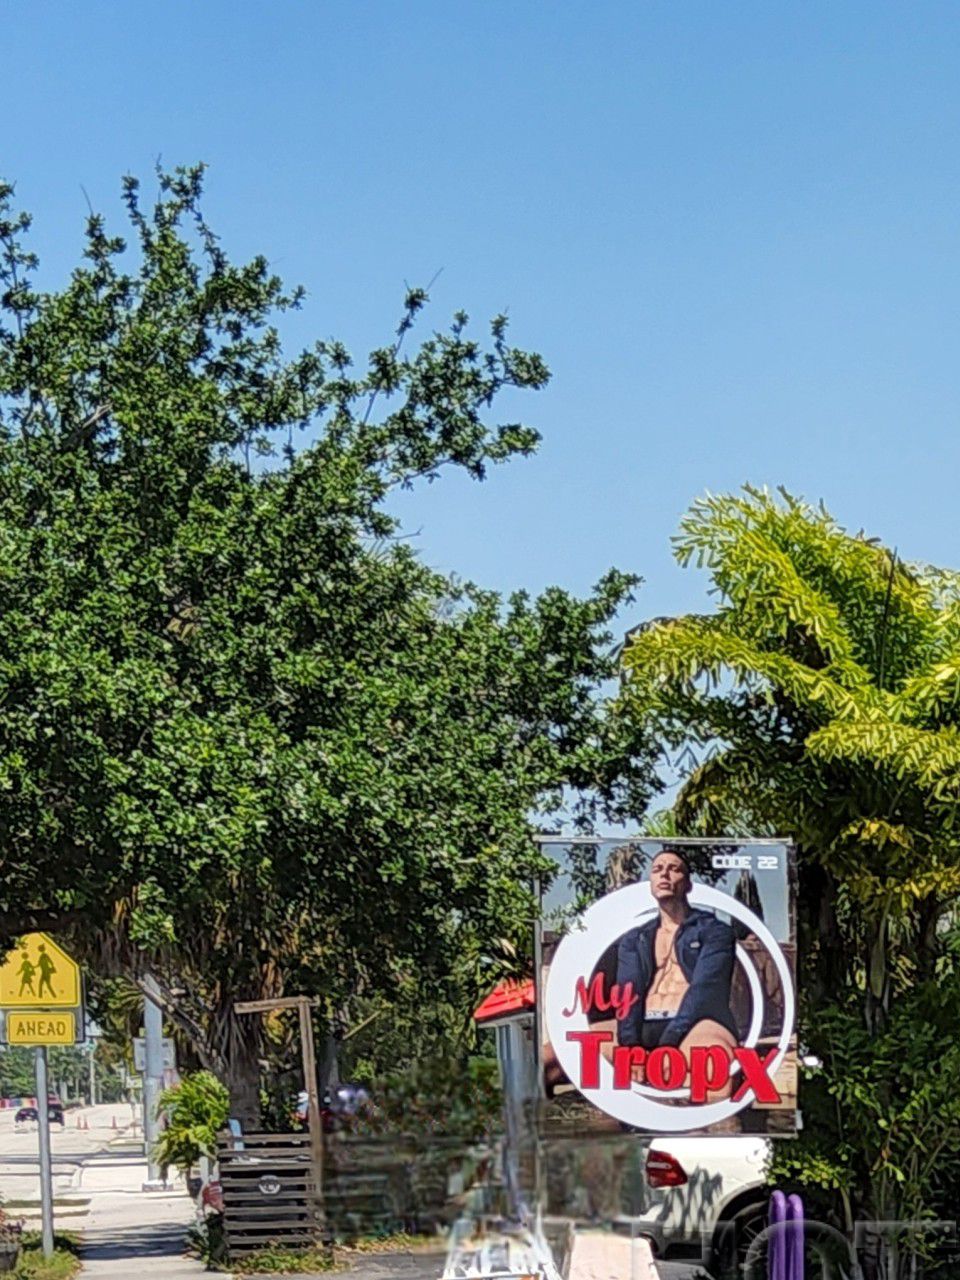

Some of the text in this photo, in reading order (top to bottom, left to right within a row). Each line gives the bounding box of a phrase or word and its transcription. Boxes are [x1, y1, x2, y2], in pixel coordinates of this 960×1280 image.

[712, 855, 779, 869] CODE 22
[562, 972, 639, 1020] My
[16, 1020, 66, 1036] AHEAD
